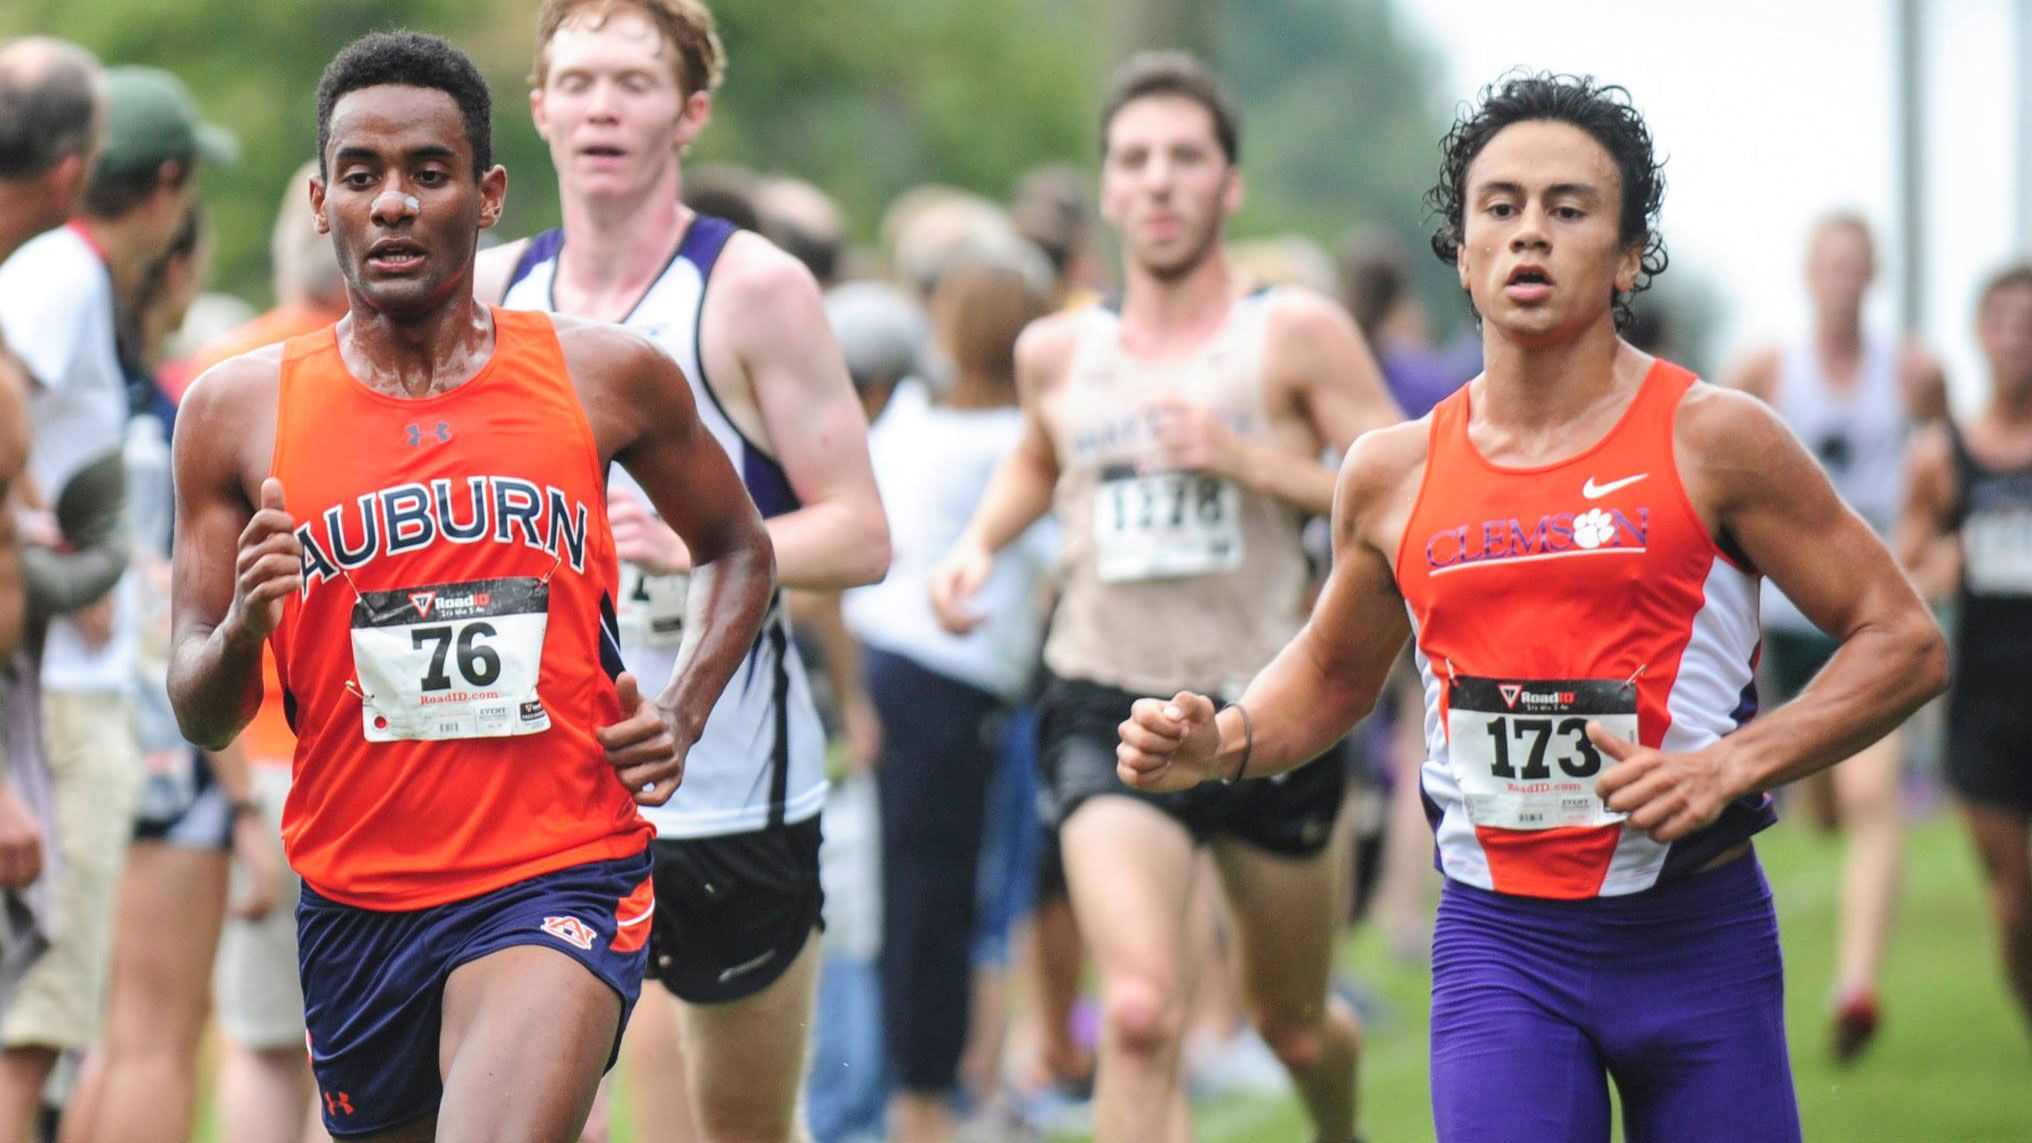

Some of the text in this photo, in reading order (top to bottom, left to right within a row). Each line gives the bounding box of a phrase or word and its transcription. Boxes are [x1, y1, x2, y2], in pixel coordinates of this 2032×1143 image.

[295, 476, 588, 603] AUBURN
[435, 592, 491, 610] RoadID
[411, 622, 501, 692] 76
[420, 690, 499, 705] RoadID.com
[1521, 691, 1576, 704] RoadID
[1487, 717, 1601, 780] 173
[1507, 783, 1582, 794] RoadID.com
